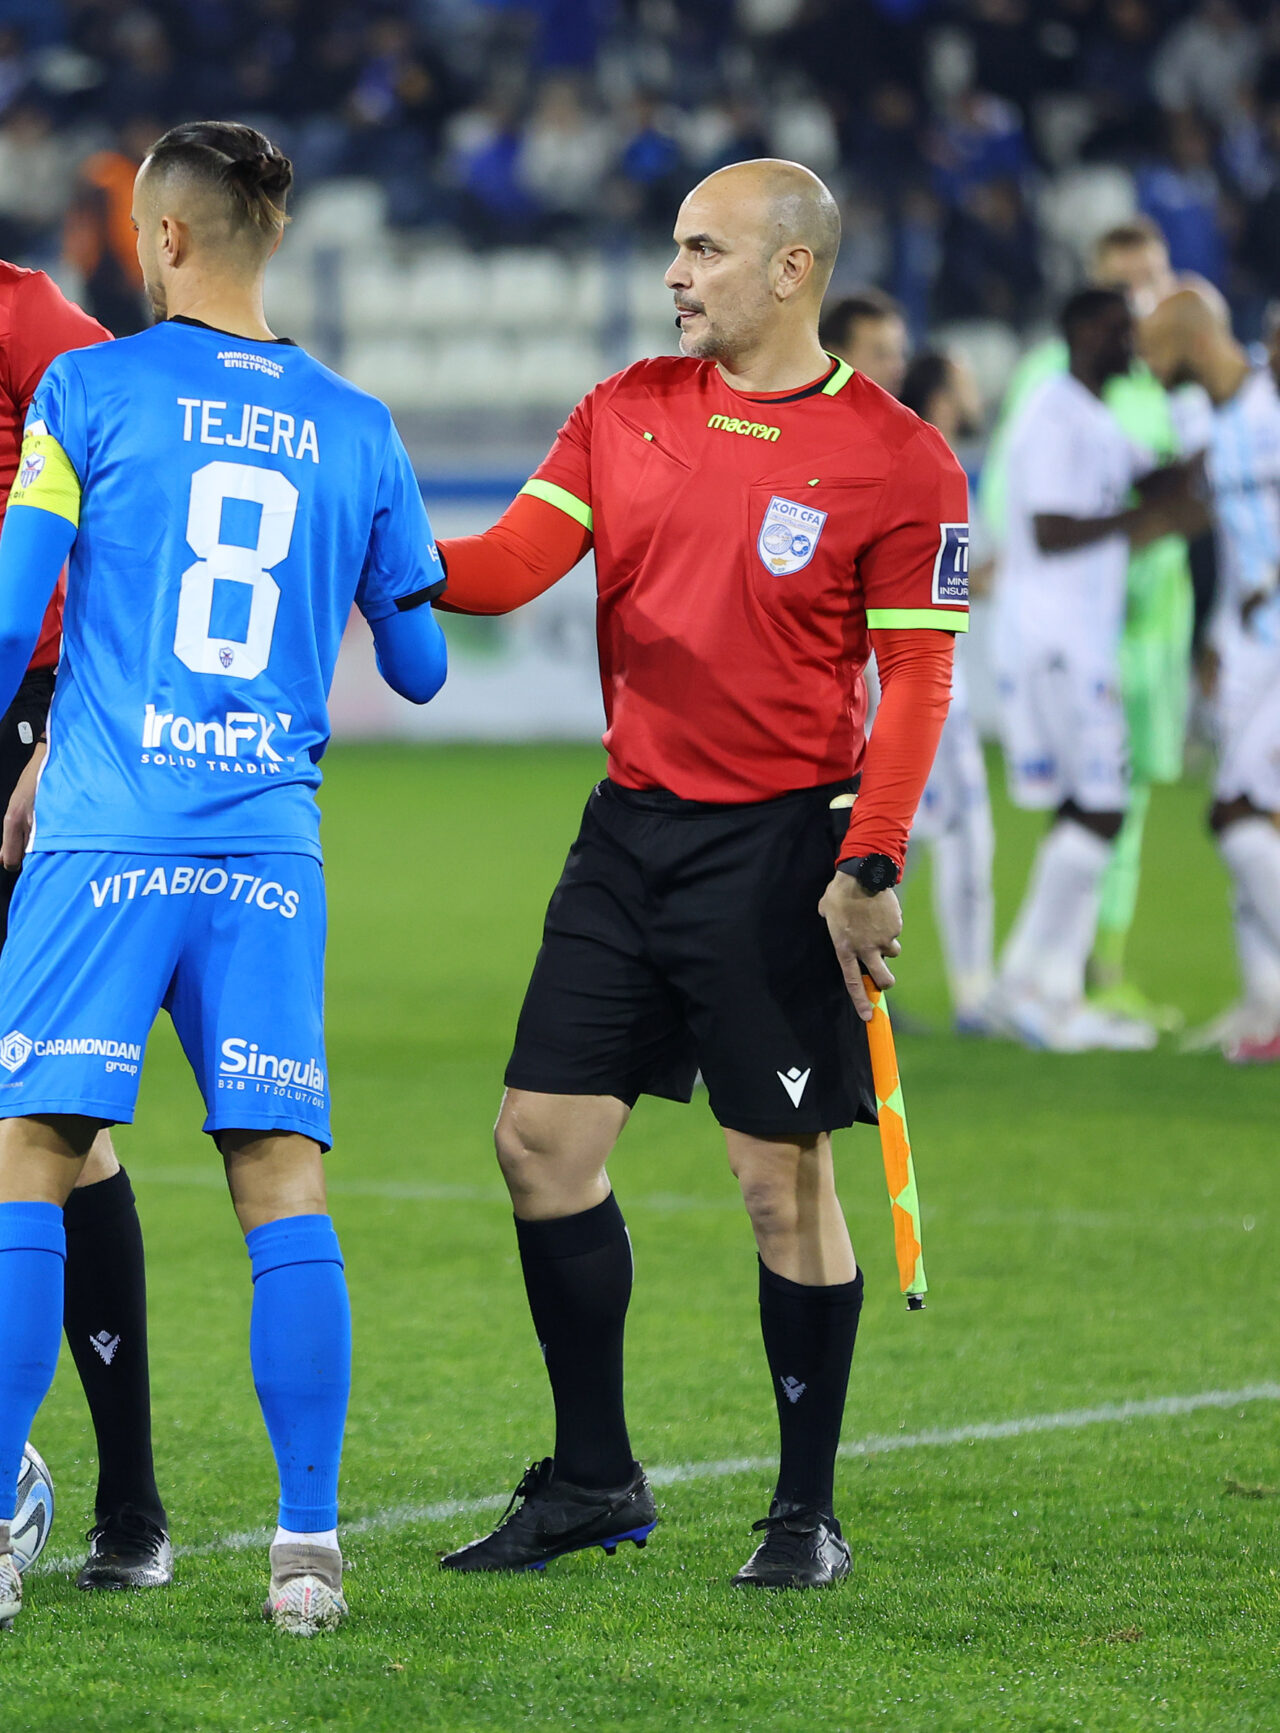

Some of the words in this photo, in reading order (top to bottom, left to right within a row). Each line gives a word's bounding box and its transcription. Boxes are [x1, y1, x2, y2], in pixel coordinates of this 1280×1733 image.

[177, 397, 320, 464] TEJERA
[707, 414, 781, 442] macron
[801, 511, 820, 525] CFA
[173, 460, 300, 681] 8
[141, 754, 196, 768] SOLID
[90, 867, 300, 919] VITABIOTICS
[34, 1038, 141, 1061] CARAMONDANI
[105, 1060, 137, 1076] group
[218, 1079, 245, 1090] B2B
[256, 1083, 270, 1093] IT
